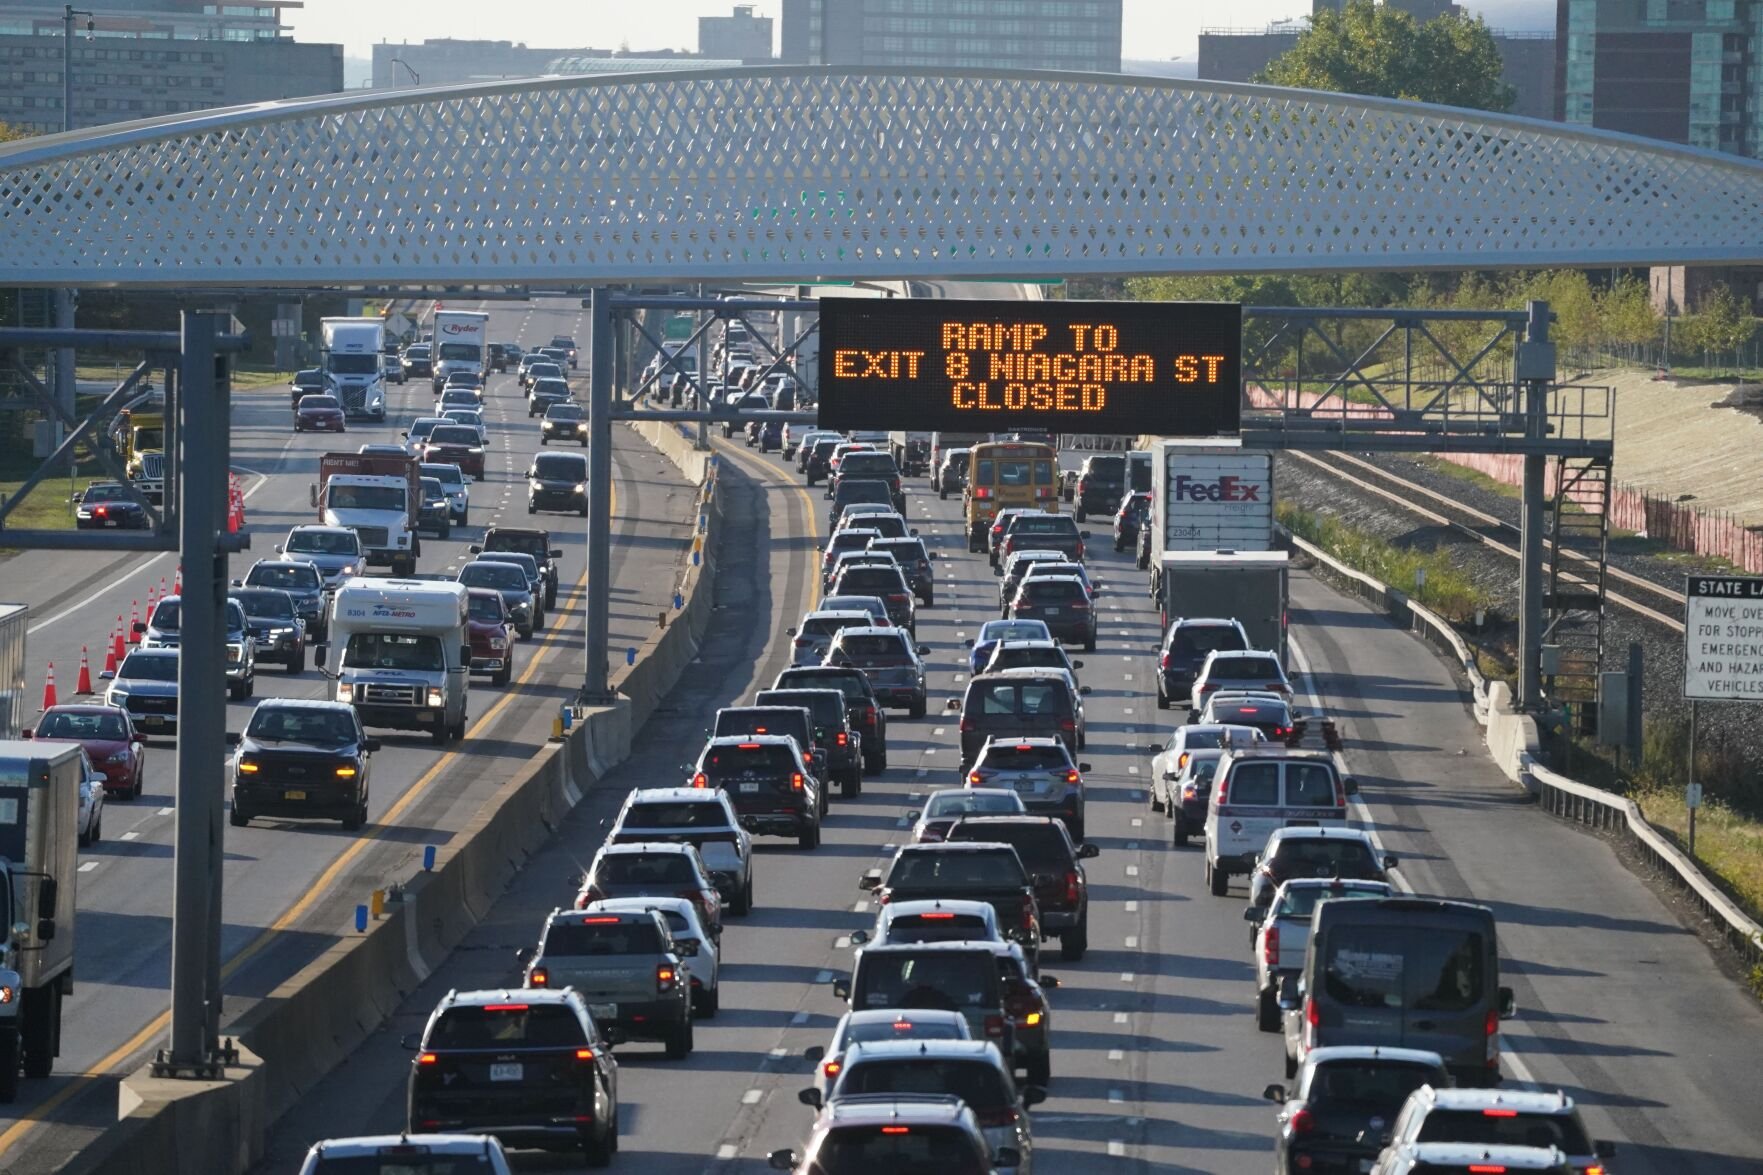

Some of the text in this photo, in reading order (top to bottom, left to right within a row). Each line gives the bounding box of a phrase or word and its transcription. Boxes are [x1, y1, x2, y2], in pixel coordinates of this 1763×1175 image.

[451, 324, 479, 333] Ryder
[942, 322, 1118, 352] RAMP TO
[834, 349, 1225, 383] EXIT 8 NIAGARA ST
[952, 381, 1106, 411] CLOSED
[323, 458, 344, 466] RENT
[1176, 475, 1260, 502] FedEx
[1224, 504, 1255, 513] Freight
[1698, 581, 1742, 595] STATE
[1705, 606, 1736, 618] MOVE
[1698, 625, 1763, 638] FOR STOPP
[1698, 662, 1722, 673] AND
[1708, 680, 1763, 693] VEHICLES
